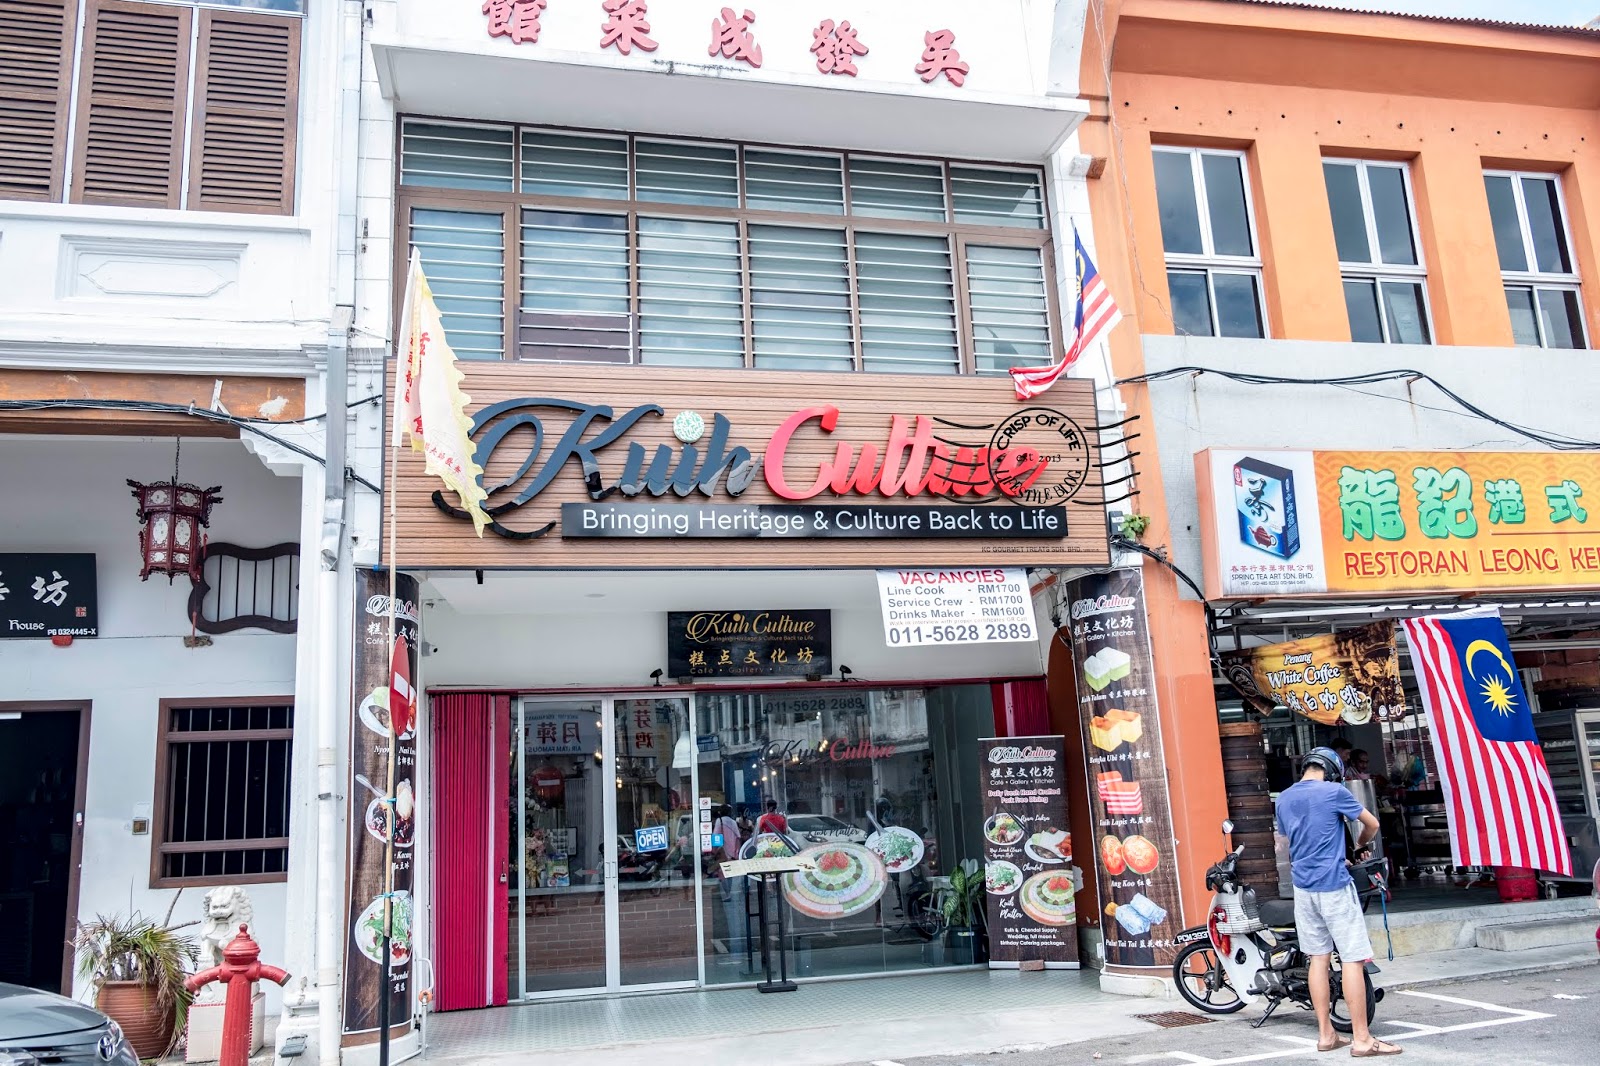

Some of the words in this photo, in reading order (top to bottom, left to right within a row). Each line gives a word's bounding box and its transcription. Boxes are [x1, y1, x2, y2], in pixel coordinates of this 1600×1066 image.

[763, 404, 1049, 500] Culture
[583, 508, 689, 533] Bringing
[699, 507, 805, 533] Heritage
[813, 510, 829, 530] &
[835, 509, 921, 530] Culture
[929, 509, 983, 530] Back
[989, 511, 1013, 530] to
[1020, 508, 1059, 530] Life
[1344, 549, 1469, 577] RESTORAN
[1479, 547, 1559, 573] LEONG
[898, 569, 1006, 585] VACANCIES
[1231, 573, 1255, 581] SPRING
[887, 586, 912, 596] Line
[914, 585, 945, 595] Cook
[977, 584, 1021, 594] RM1700
[888, 597, 931, 608] Service
[934, 597, 963, 607] Crew
[979, 595, 1023, 605] RM1700
[890, 609, 928, 620] Drinks
[931, 608, 965, 619] Maker
[981, 607, 1025, 617] RM1600
[58, 628, 96, 636] 0324445-X
[685, 612, 751, 644] Kuih
[752, 613, 816, 634] Culture
[889, 624, 980, 644] 011-5628
[985, 623, 1031, 640] 2889
[1283, 652, 1313, 666] Penang
[1266, 669, 1303, 689] White
[1303, 663, 1341, 686] Coffee
[639, 832, 665, 848] OPEN
[1122, 879, 1136, 887] Koo
[1118, 940, 1127, 948] Tai
[1128, 940, 1138, 948] Tai
[1177, 933, 1193, 943] PCM
